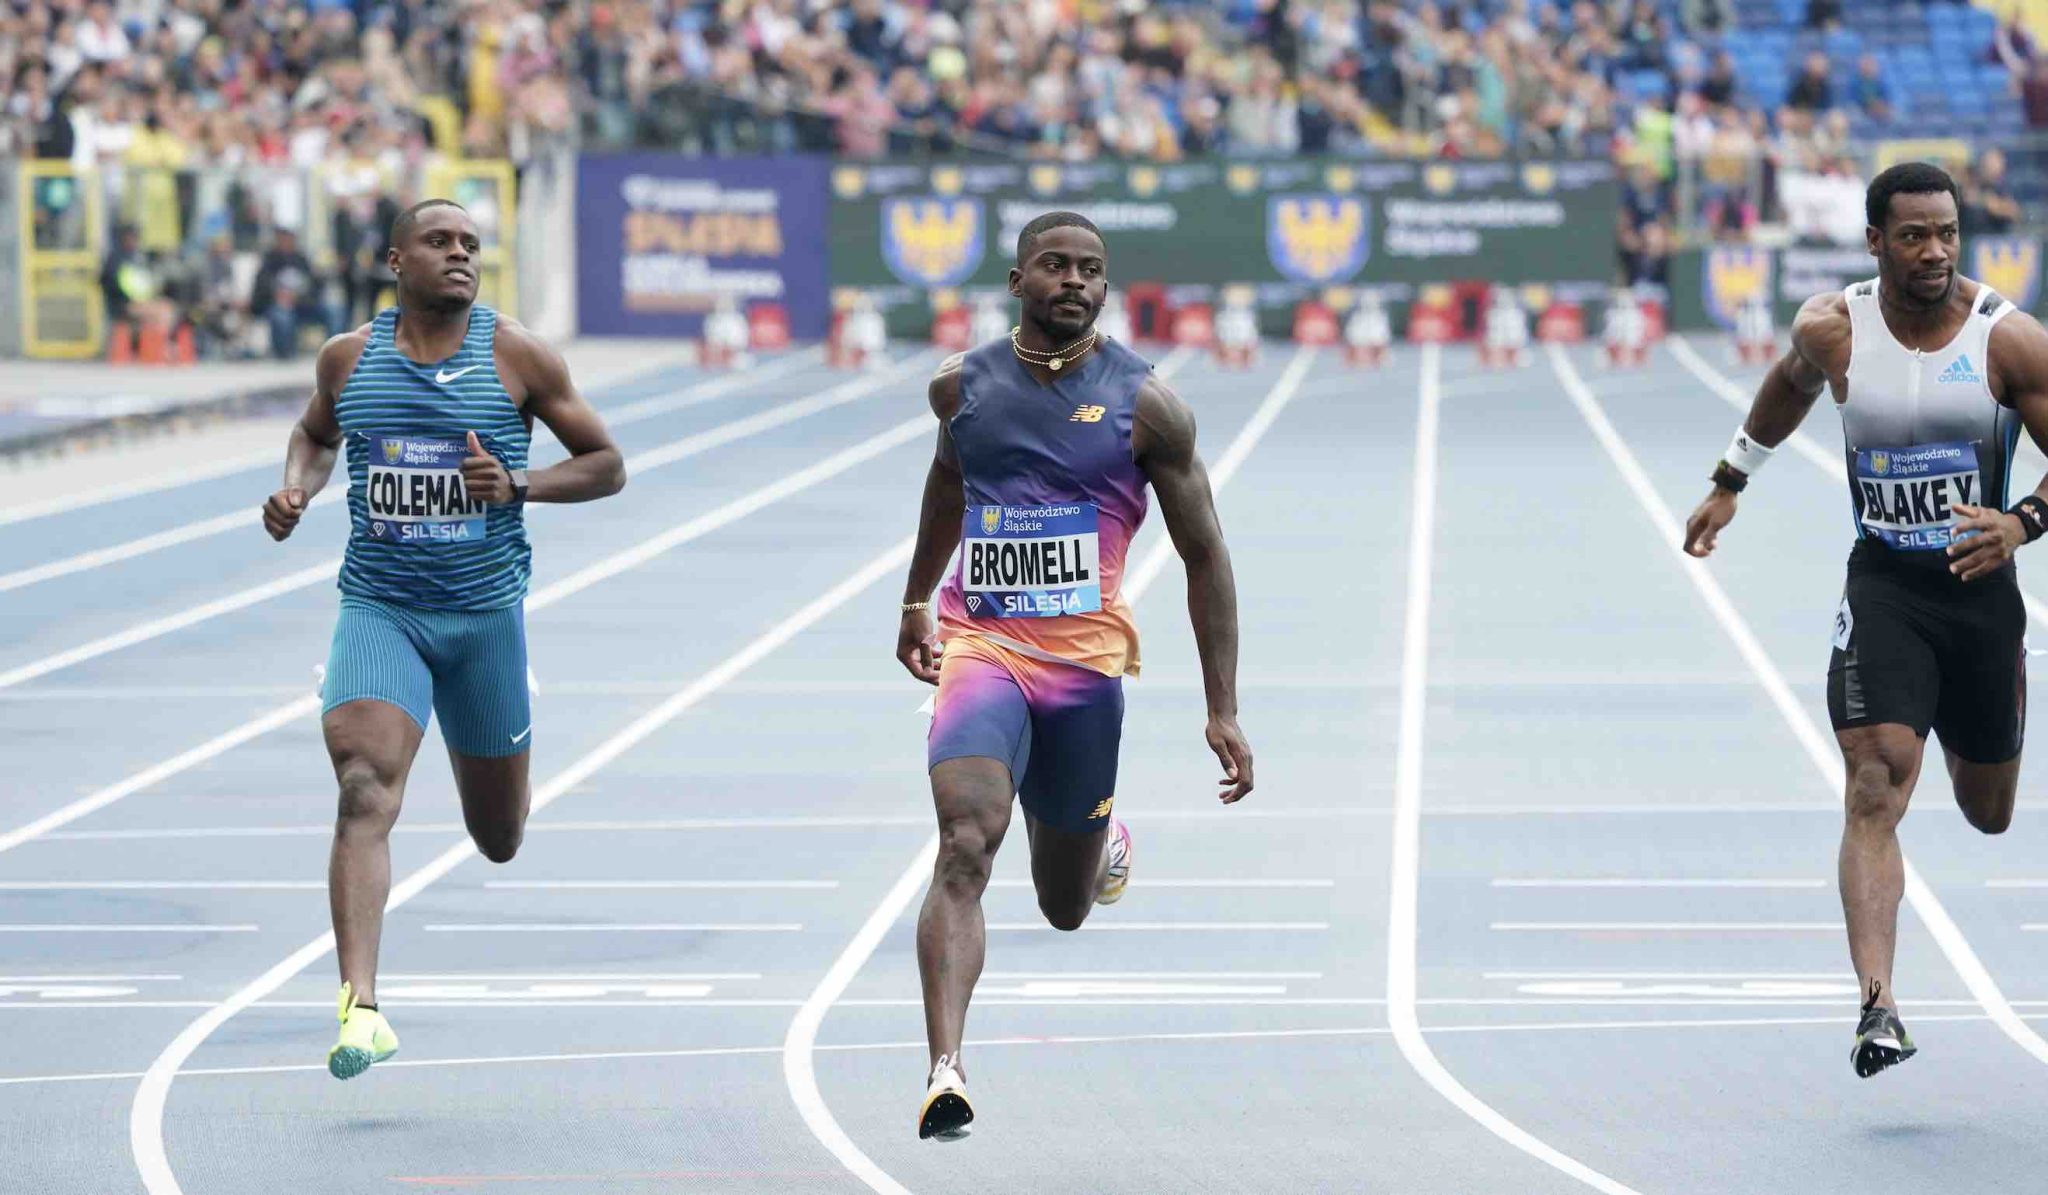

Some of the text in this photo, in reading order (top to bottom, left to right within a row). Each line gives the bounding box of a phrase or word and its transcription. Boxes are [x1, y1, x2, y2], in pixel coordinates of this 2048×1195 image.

[1937, 372, 1981, 384] adidas
[1891, 448, 1962, 466] Województwo
[1861, 477, 1952, 526] BLAKE
[1003, 505, 1081, 521] Województwo
[401, 522, 470, 540] SILESIA
[1003, 520, 1043, 534] Śląskie
[969, 538, 1090, 587] BROMELL
[1004, 593, 1083, 613] SILESIA
